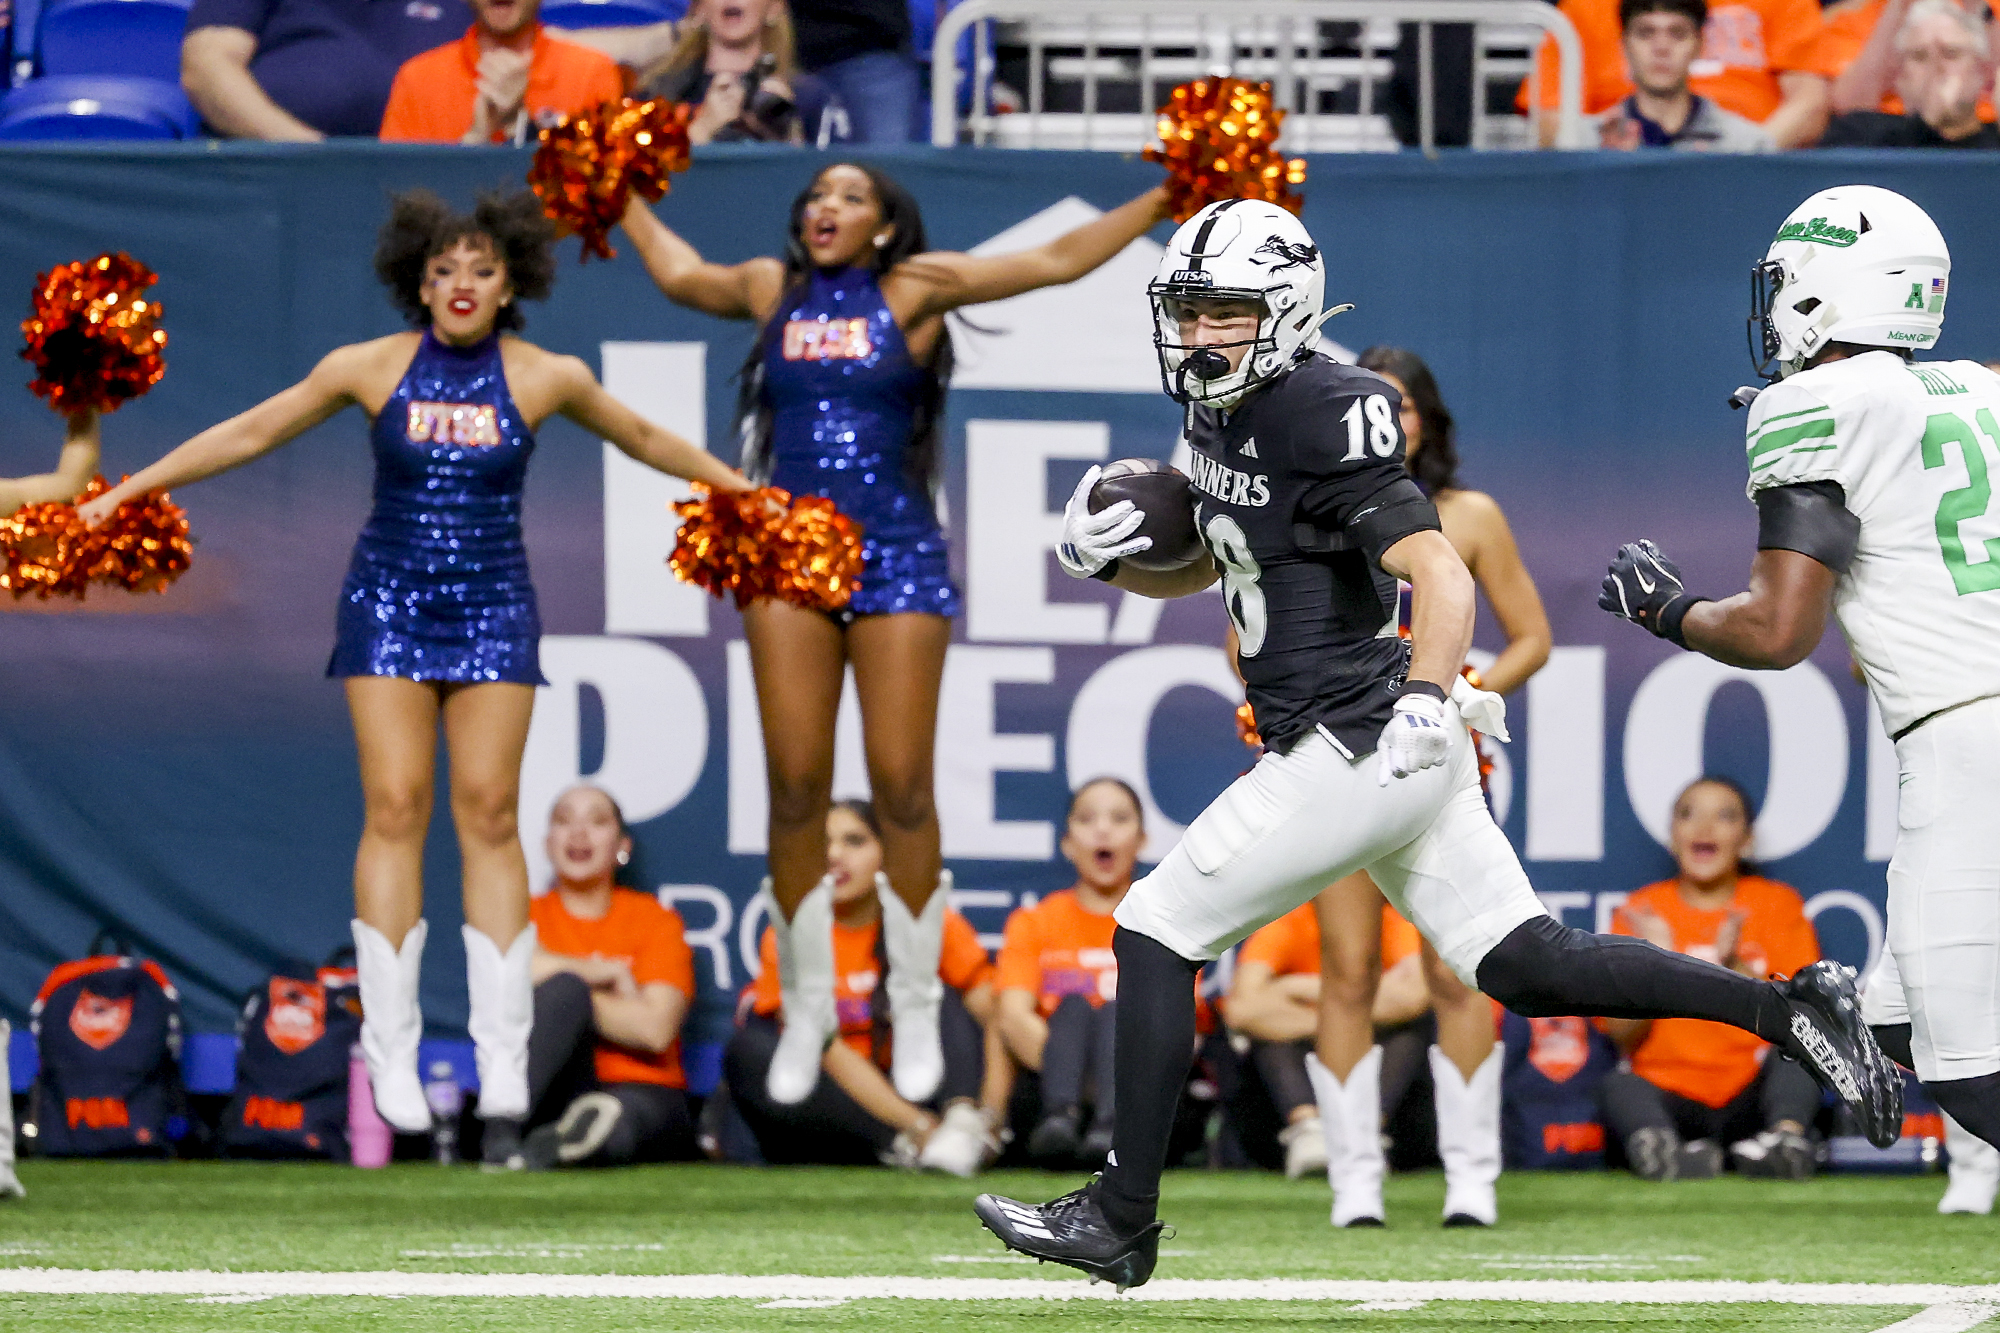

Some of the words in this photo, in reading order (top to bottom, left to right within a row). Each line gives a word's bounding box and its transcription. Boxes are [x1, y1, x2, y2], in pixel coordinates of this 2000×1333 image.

[1804, 217, 1858, 247] Green
[1174, 271, 1207, 282] UTSA
[1887, 331, 1916, 342] MEAN
[1903, 367, 1970, 396] HILL
[407, 401, 502, 447] UTSA
[1339, 393, 1399, 463] 18
[1920, 406, 2000, 596] 2
